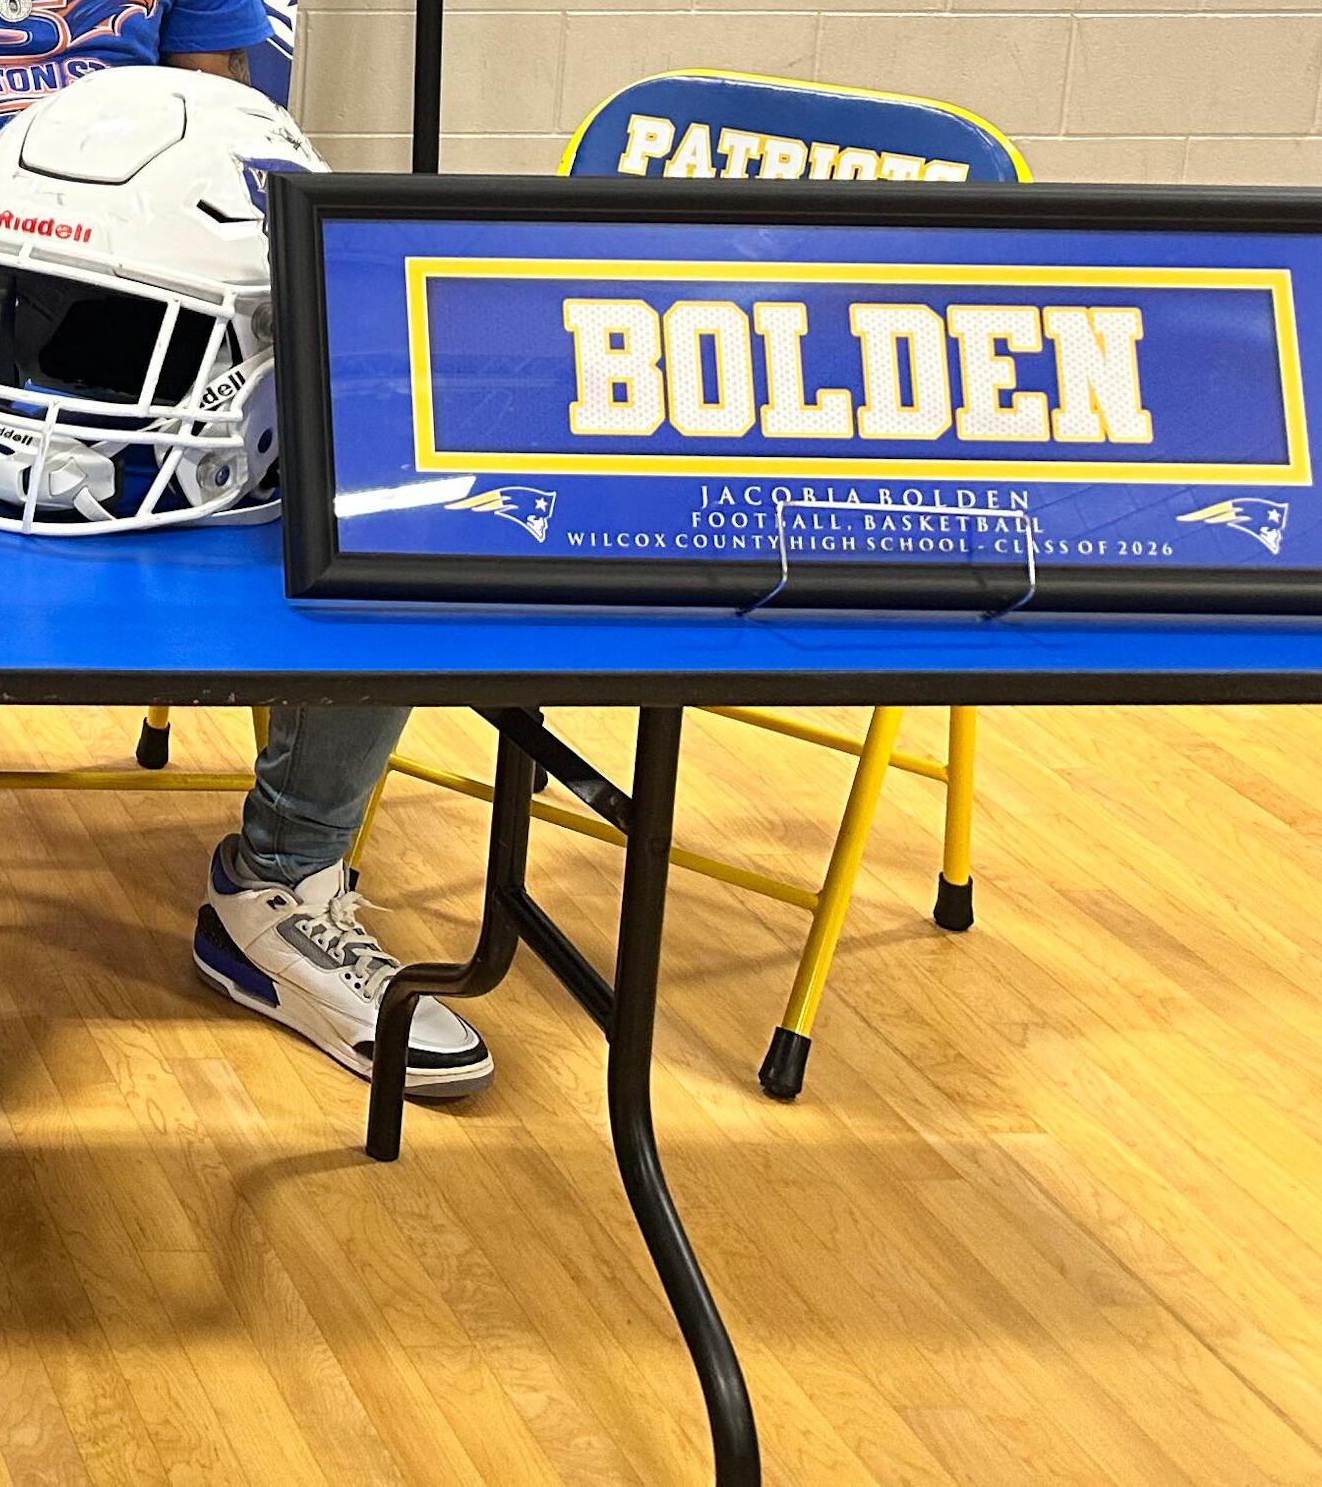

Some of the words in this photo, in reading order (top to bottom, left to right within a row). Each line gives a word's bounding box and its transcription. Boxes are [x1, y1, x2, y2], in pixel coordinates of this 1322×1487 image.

[562, 298, 1155, 444] BOLDEN
[878, 488, 1029, 509] BOLDEN
[864, 514, 1045, 533] BASKETBALL
[567, 532, 667, 548] WILCOX
[675, 533, 780, 550] COUNTY
[789, 536, 857, 551] HIGH
[866, 537, 971, 552] SCHOOL
[1077, 539, 1108, 555] OF
[1117, 540, 1174, 556] 2026
